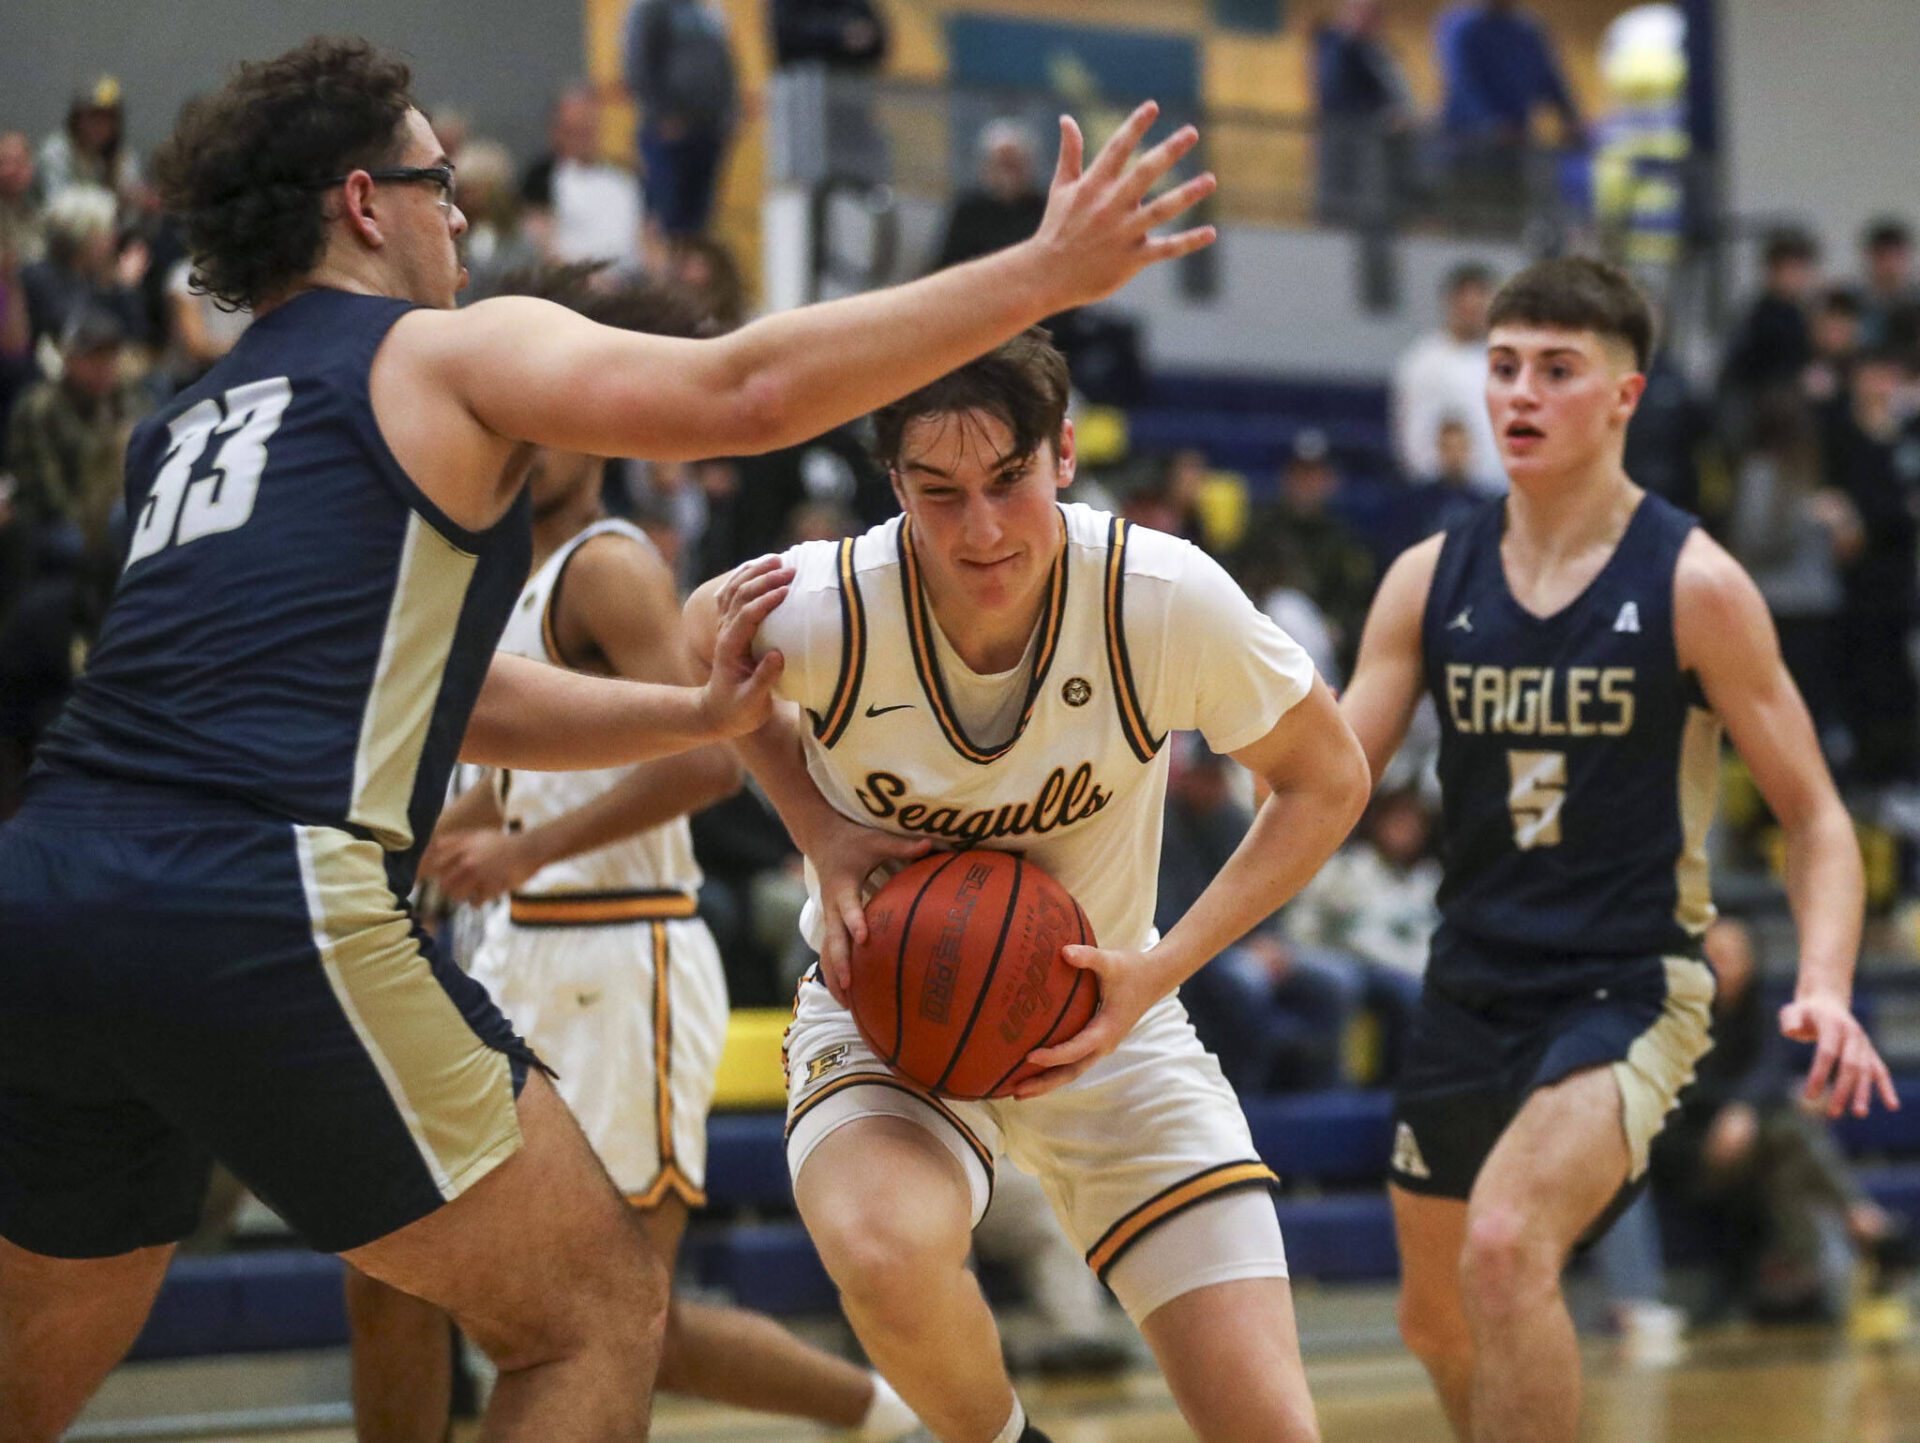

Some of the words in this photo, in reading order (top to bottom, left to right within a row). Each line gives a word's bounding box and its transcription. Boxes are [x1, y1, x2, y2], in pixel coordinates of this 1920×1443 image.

[123, 376, 293, 574] 33
[1445, 663, 1637, 737] EAGLES
[855, 762, 1113, 851] Seagulls
[1508, 750, 1567, 850] 5
